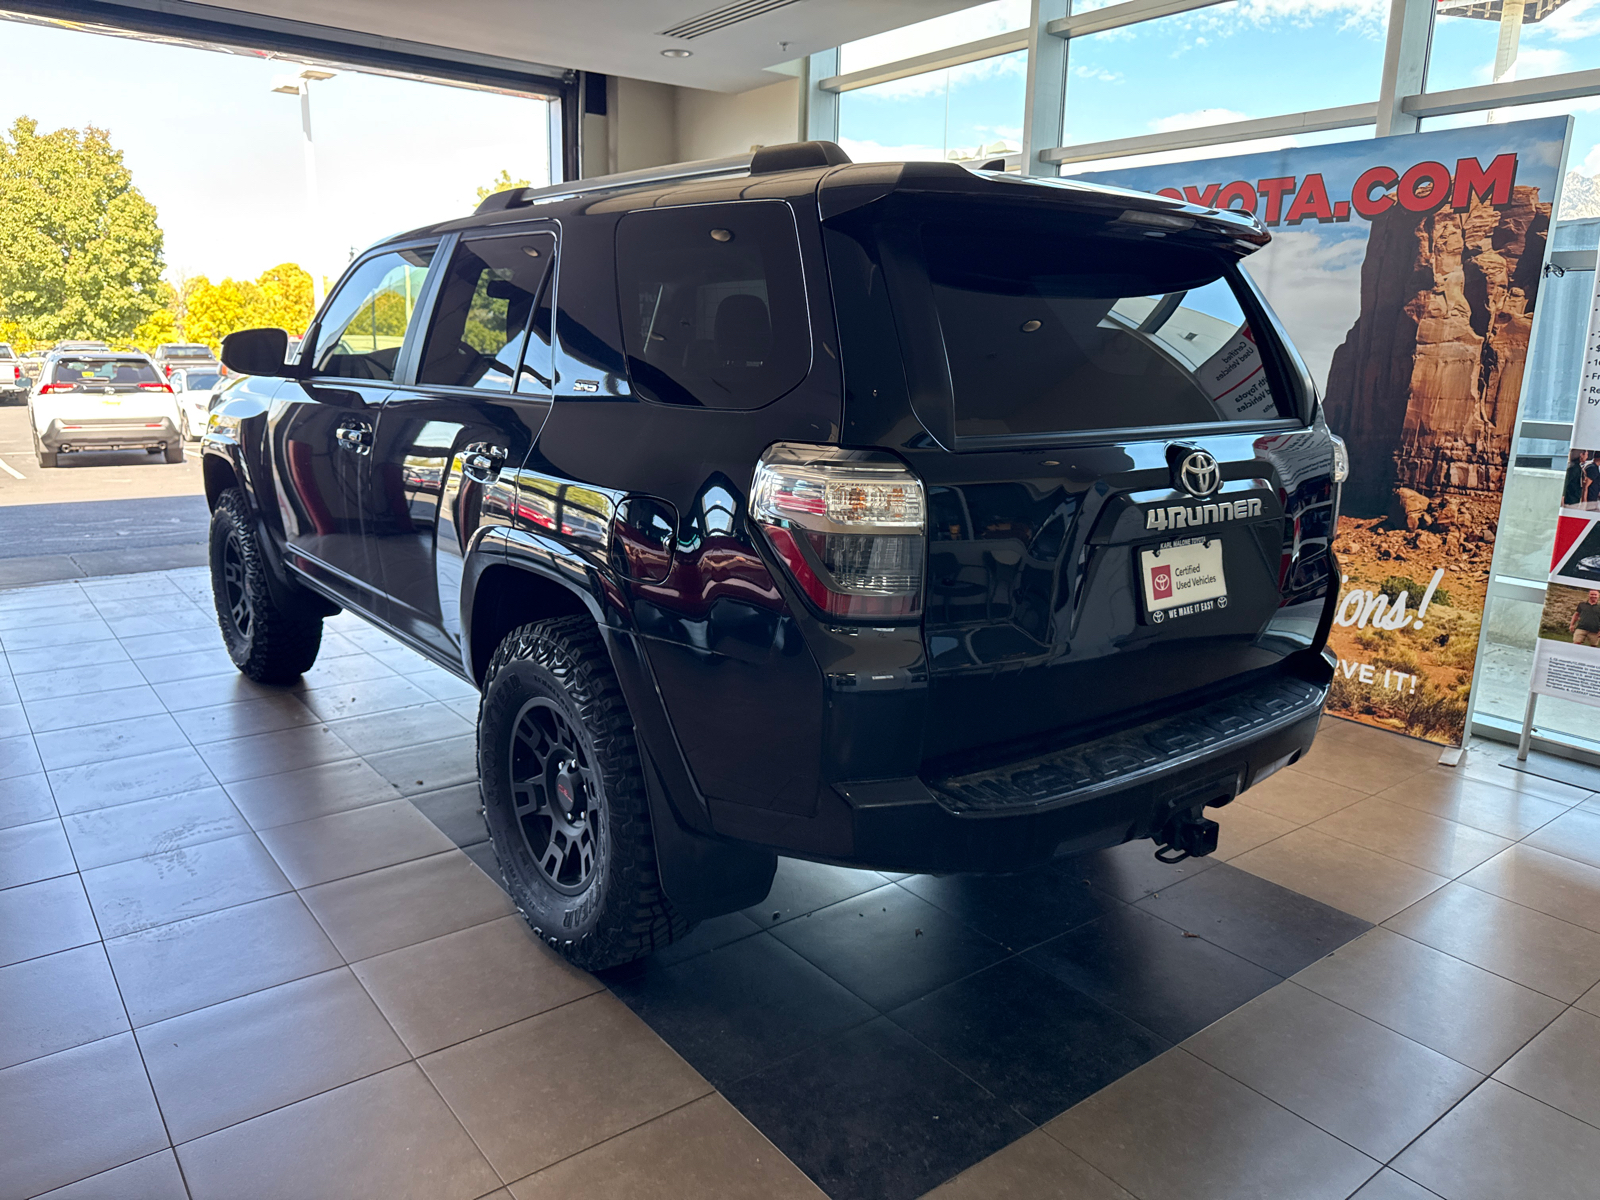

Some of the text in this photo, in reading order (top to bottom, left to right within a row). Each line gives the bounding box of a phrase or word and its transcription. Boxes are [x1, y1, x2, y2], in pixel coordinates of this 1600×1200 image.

[1143, 153, 1518, 227] YOTA.COM
[1175, 563, 1201, 577] Certified
[1176, 574, 1217, 590] Used Vehicles
[1168, 600, 1214, 619] WE MAKE IT EASY
[1335, 659, 1417, 695] VE IT!
